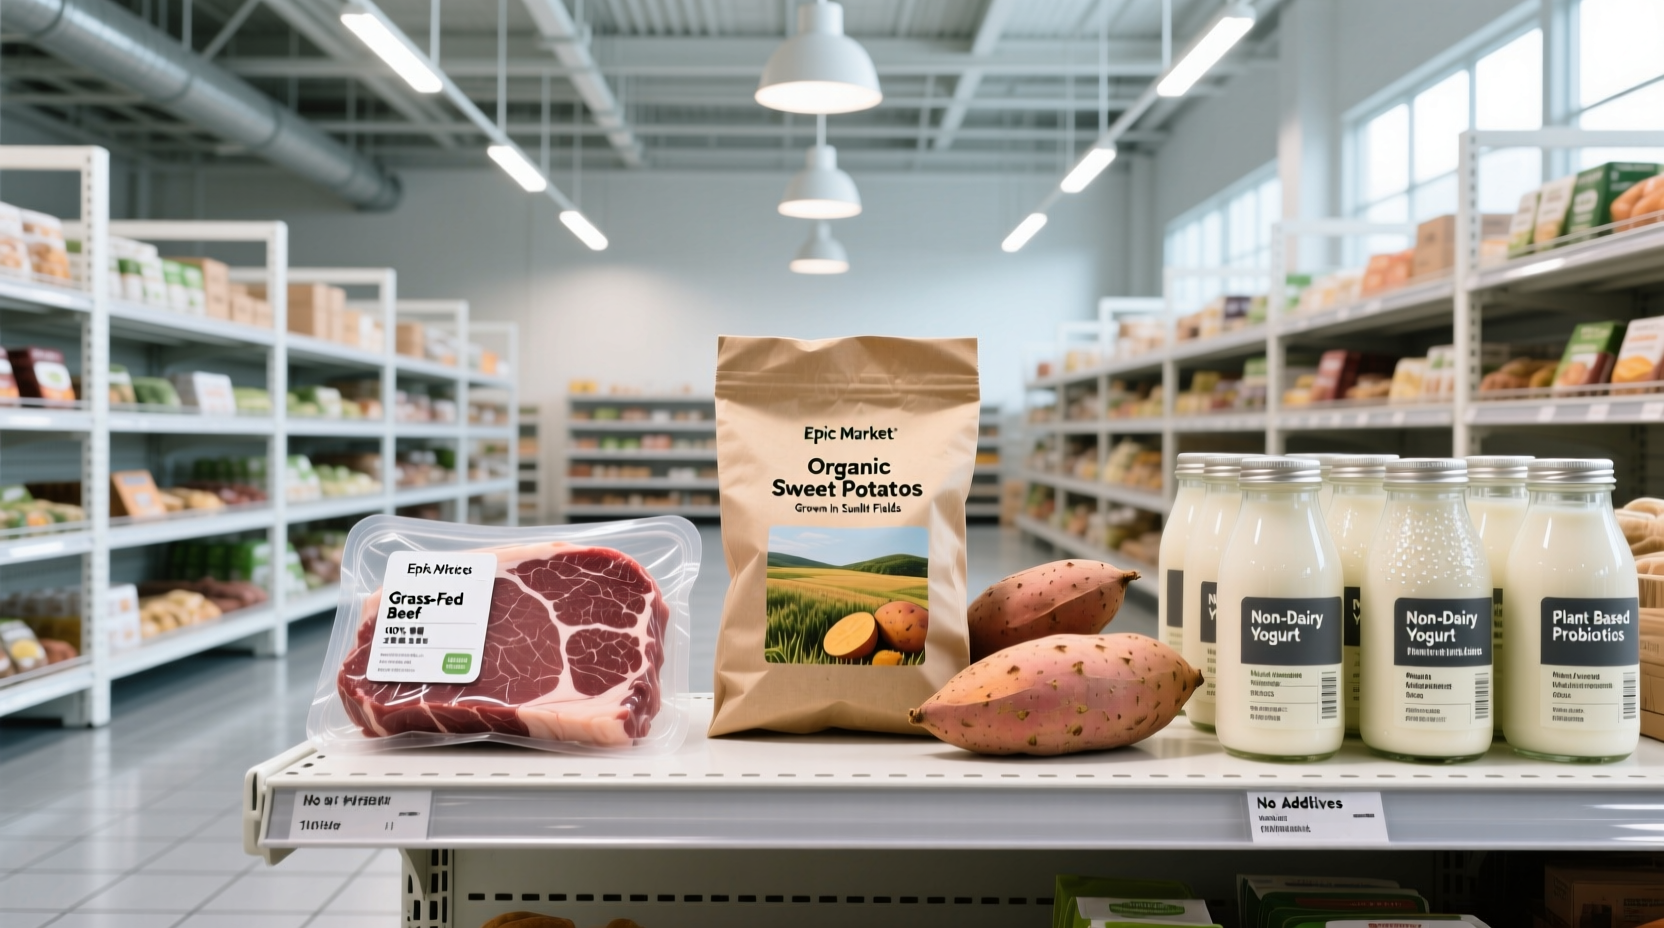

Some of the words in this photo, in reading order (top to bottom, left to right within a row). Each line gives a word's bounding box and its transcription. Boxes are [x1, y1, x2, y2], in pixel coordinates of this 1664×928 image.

[804, 425, 837, 445] Epic
[807, 457, 891, 481] Organic
[772, 478, 837, 497] Sweet
[842, 479, 923, 498] Potatos
[388, 590, 464, 606] Grass-Fed
[386, 606, 423, 620] Beef
[1251, 609, 1323, 630] Non-Dairy
[1406, 610, 1478, 630] Non-Dairy
[1552, 609, 1590, 625] Plant
[1593, 609, 1630, 625] Based
[1251, 626, 1301, 646] Yogurt
[1406, 627, 1456, 647] Yogurt
[1257, 796, 1277, 810] No
